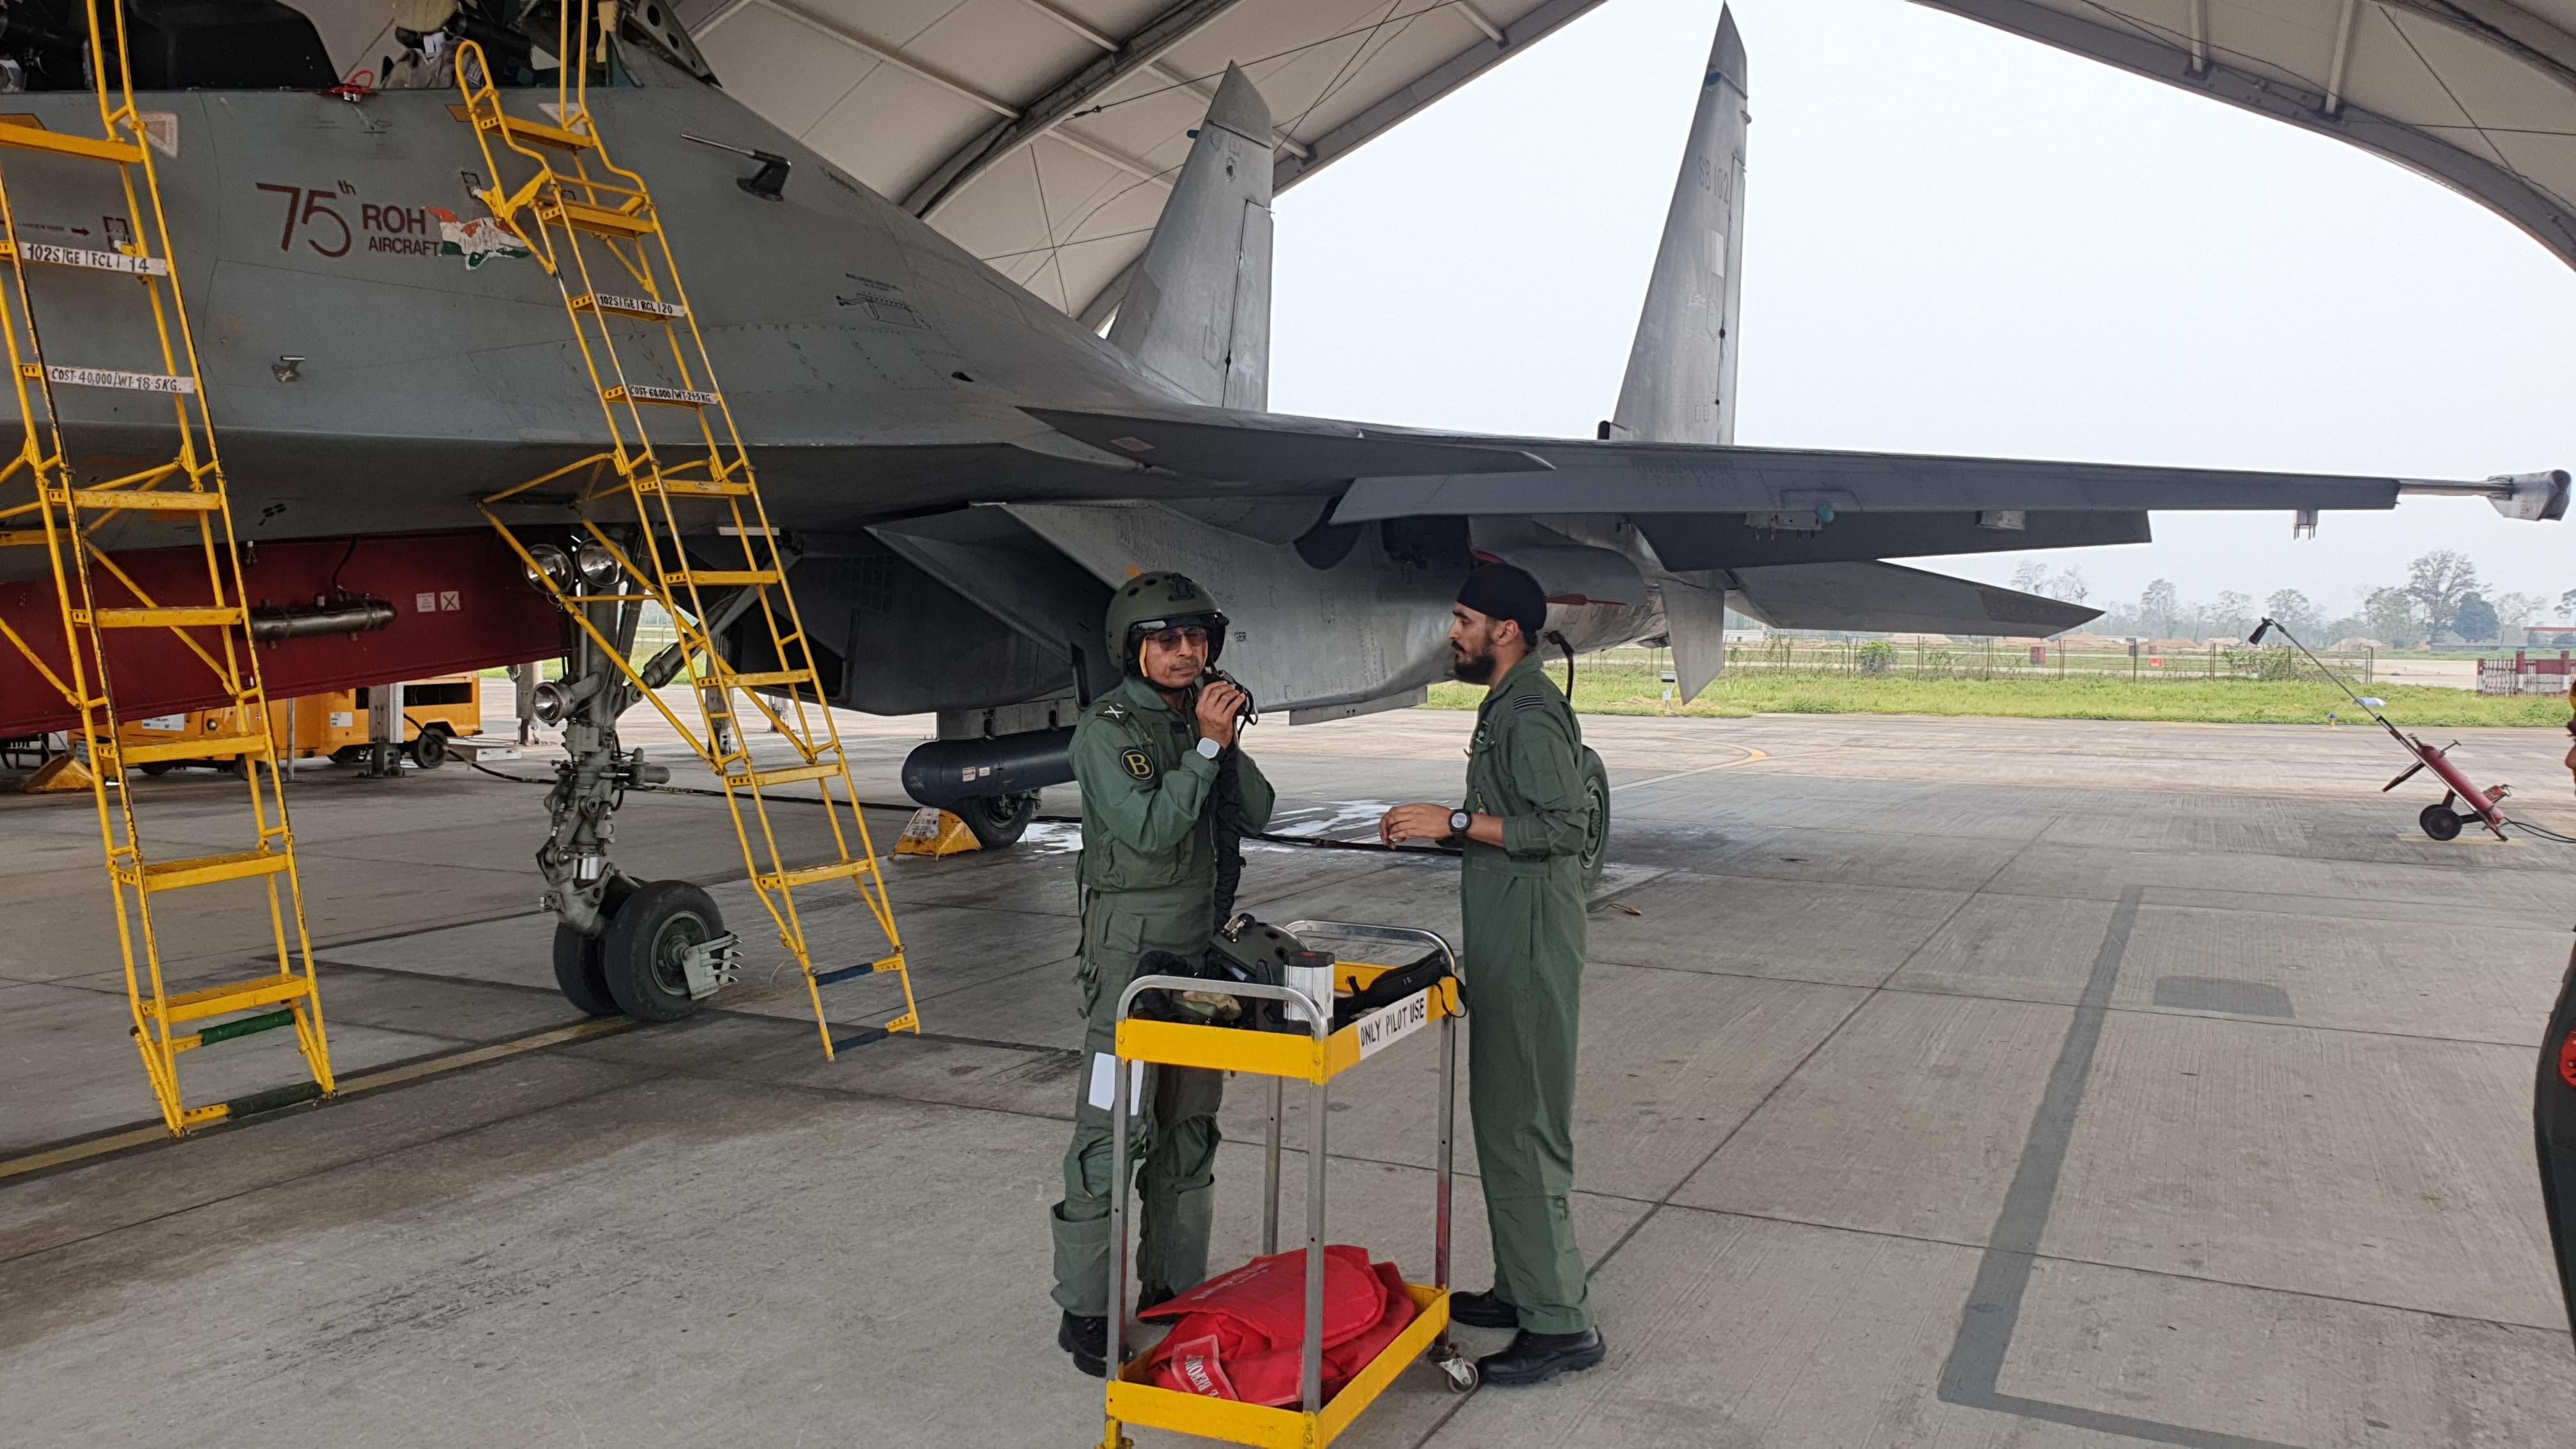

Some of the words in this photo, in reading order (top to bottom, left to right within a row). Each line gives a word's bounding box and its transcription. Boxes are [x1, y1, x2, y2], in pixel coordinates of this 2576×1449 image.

[1713, 164, 1729, 204] 102
[362, 204, 427, 235] ROH
[368, 236, 440, 257] AIRCRAFT
[1124, 754, 1151, 776] B
[1360, 1018, 1381, 1048] ONLY
[1385, 1006, 1408, 1037] PILOT
[1409, 997, 1425, 1023] USE
